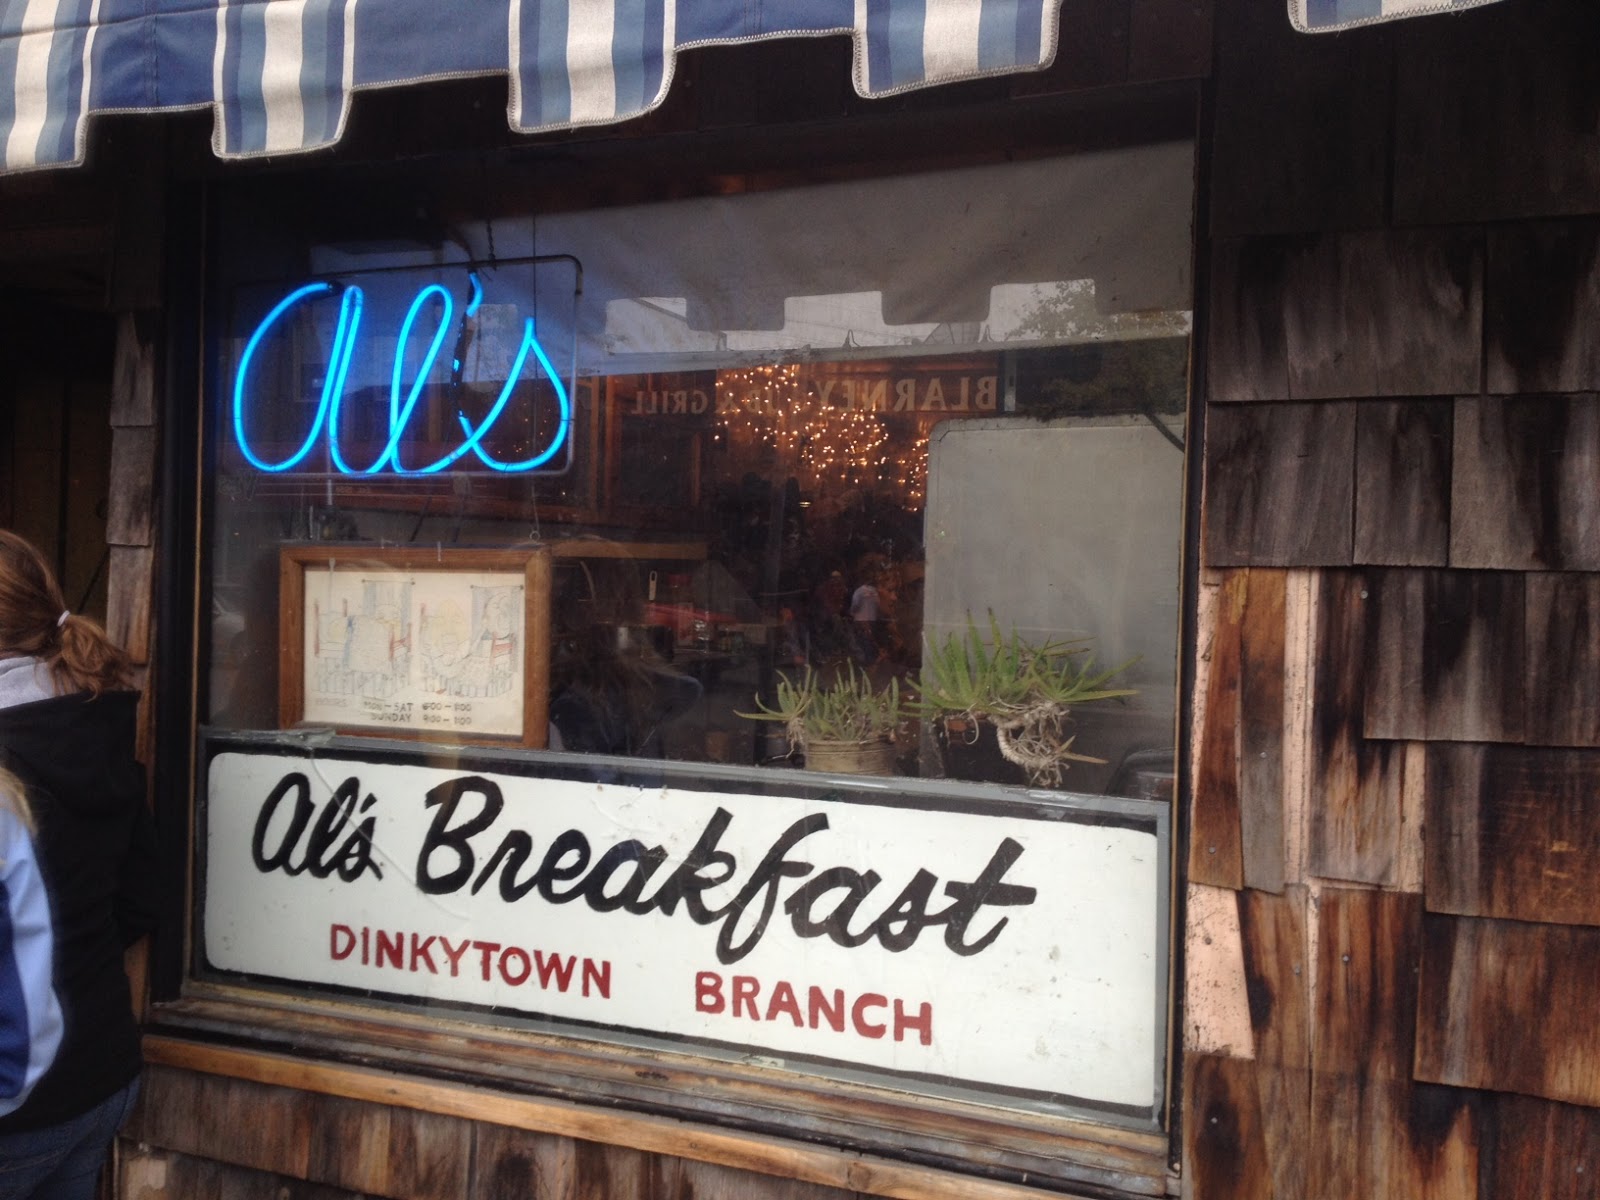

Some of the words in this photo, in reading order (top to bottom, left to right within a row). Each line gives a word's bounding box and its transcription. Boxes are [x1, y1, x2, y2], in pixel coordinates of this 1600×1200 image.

[371, 713, 412, 722] SUNDAY
[252, 772, 383, 883] Al's
[416, 775, 1037, 965] Breakfast
[330, 923, 612, 999] DINKYTOWN
[695, 971, 932, 1045] BRANCH
